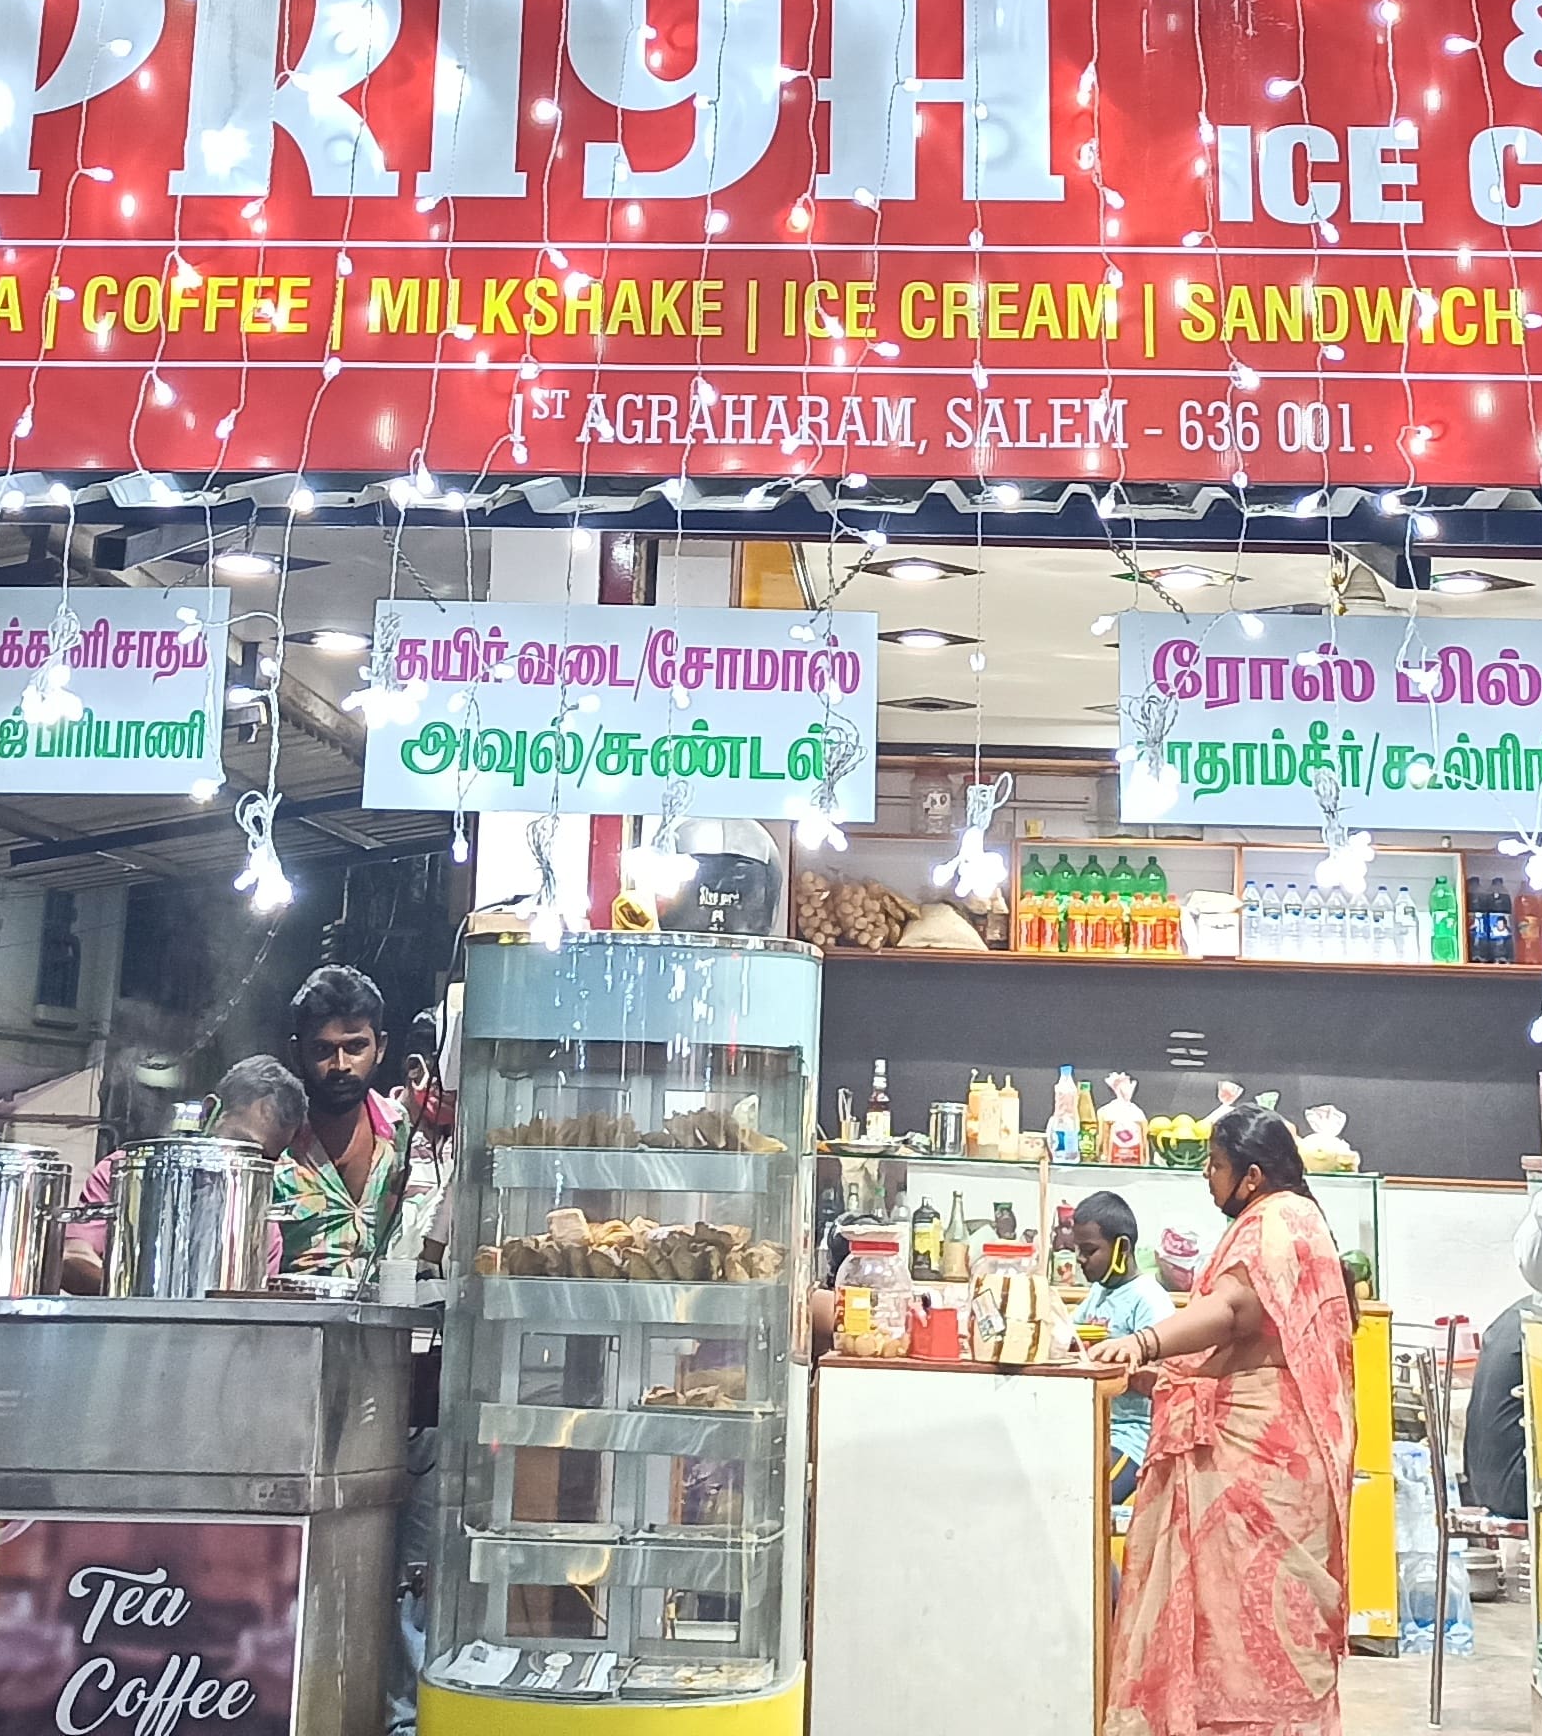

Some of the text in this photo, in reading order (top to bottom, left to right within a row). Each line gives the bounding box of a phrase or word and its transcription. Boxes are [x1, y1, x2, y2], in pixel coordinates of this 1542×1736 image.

[1217, 124, 1425, 226] ICE
[82, 274, 310, 336] COFFEE
[370, 276, 723, 338] MILKSHAKE
[783, 278, 877, 341] ICE
[900, 279, 1118, 343] CREAM
[1179, 284, 1525, 348] SANDWICH
[576, 392, 928, 455] AGRAHARAM,
[945, 395, 1129, 452] SALEM
[1178, 398, 1260, 453] 636
[1151, 639, 1375, 711] ரோஸ்
[69, 1566, 192, 1644] Tea
[55, 1654, 256, 1736] Coffee
